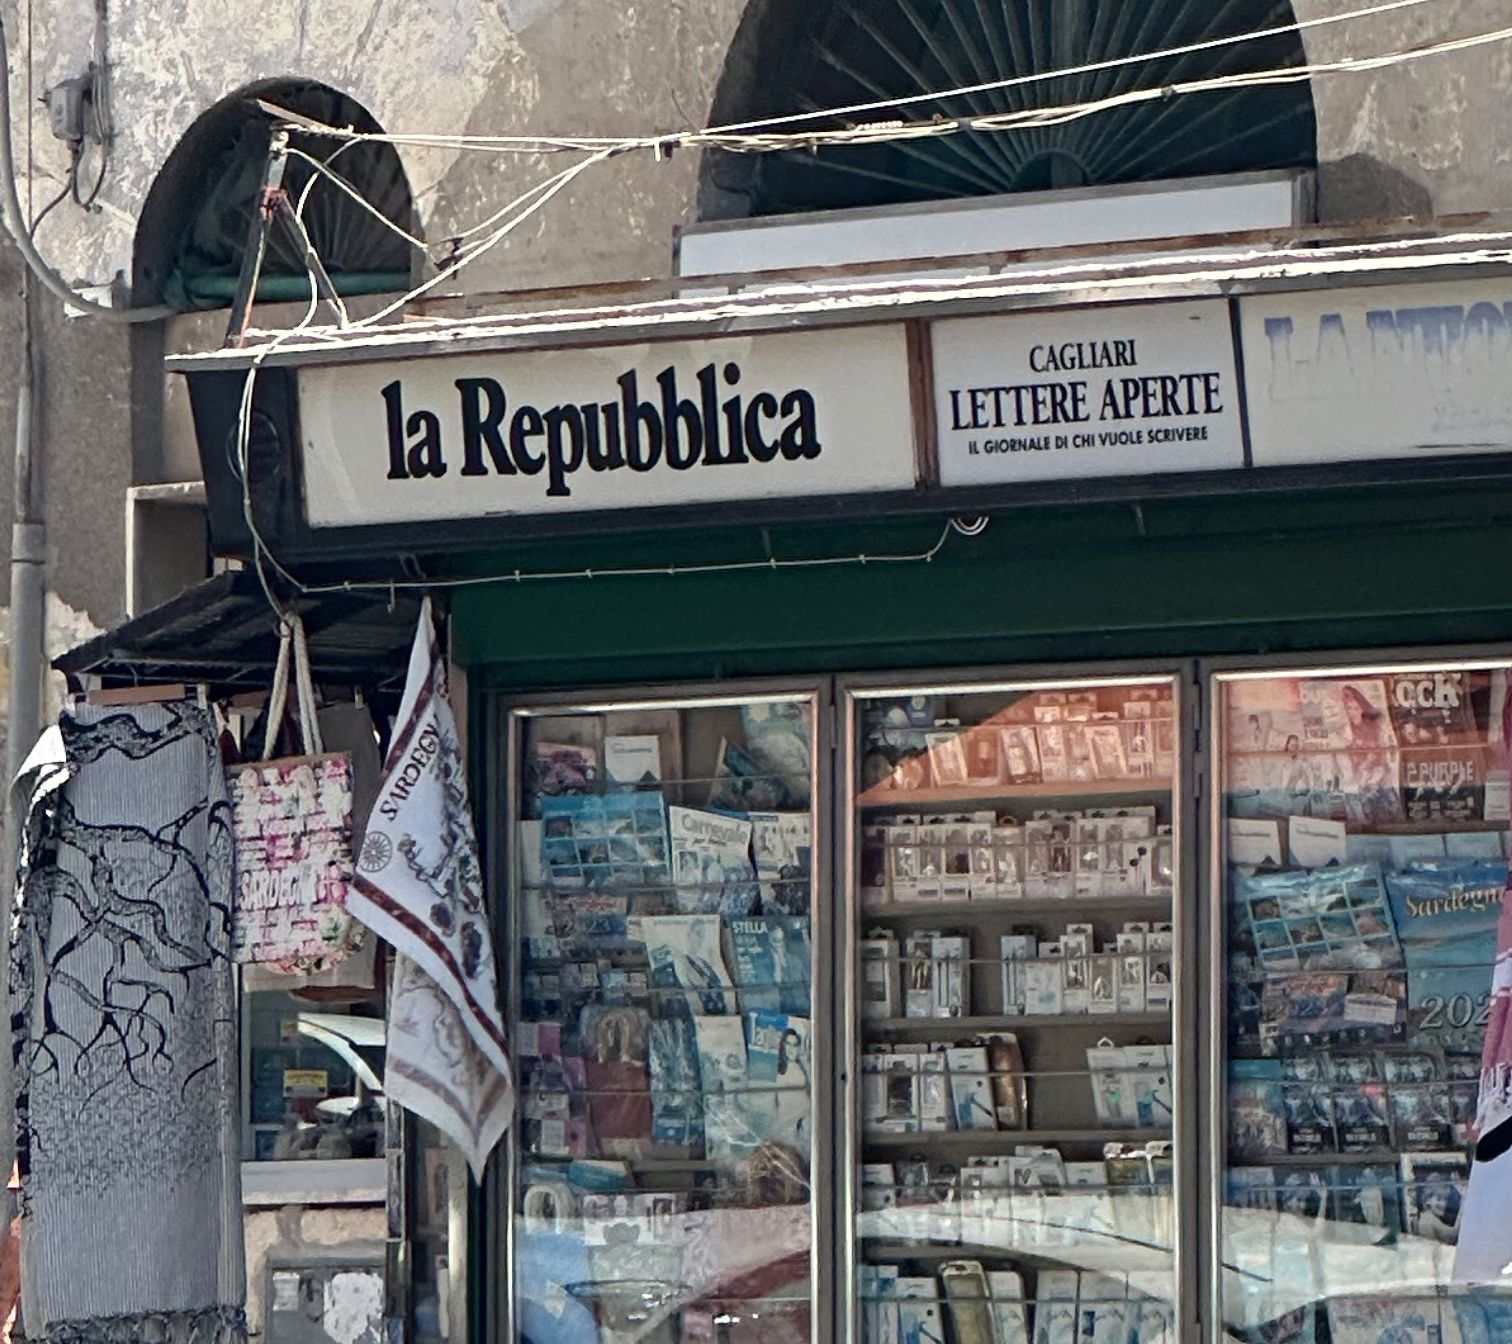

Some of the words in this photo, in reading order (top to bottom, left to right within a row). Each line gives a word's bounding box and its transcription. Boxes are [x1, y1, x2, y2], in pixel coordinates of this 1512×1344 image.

[1029, 339, 1138, 373] CAGLIARI
[949, 380, 1091, 430] LETTERE
[1099, 372, 1224, 421] APERTE
[382, 379, 447, 480] la
[455, 362, 822, 497] Repubblica
[969, 440, 980, 455] IL
[984, 436, 1050, 455] GIORNALE
[1055, 435, 1068, 450] DI
[1072, 433, 1096, 449] CHI
[1098, 429, 1144, 447] VUOLE
[1147, 426, 1209, 444] SCRIVERE
